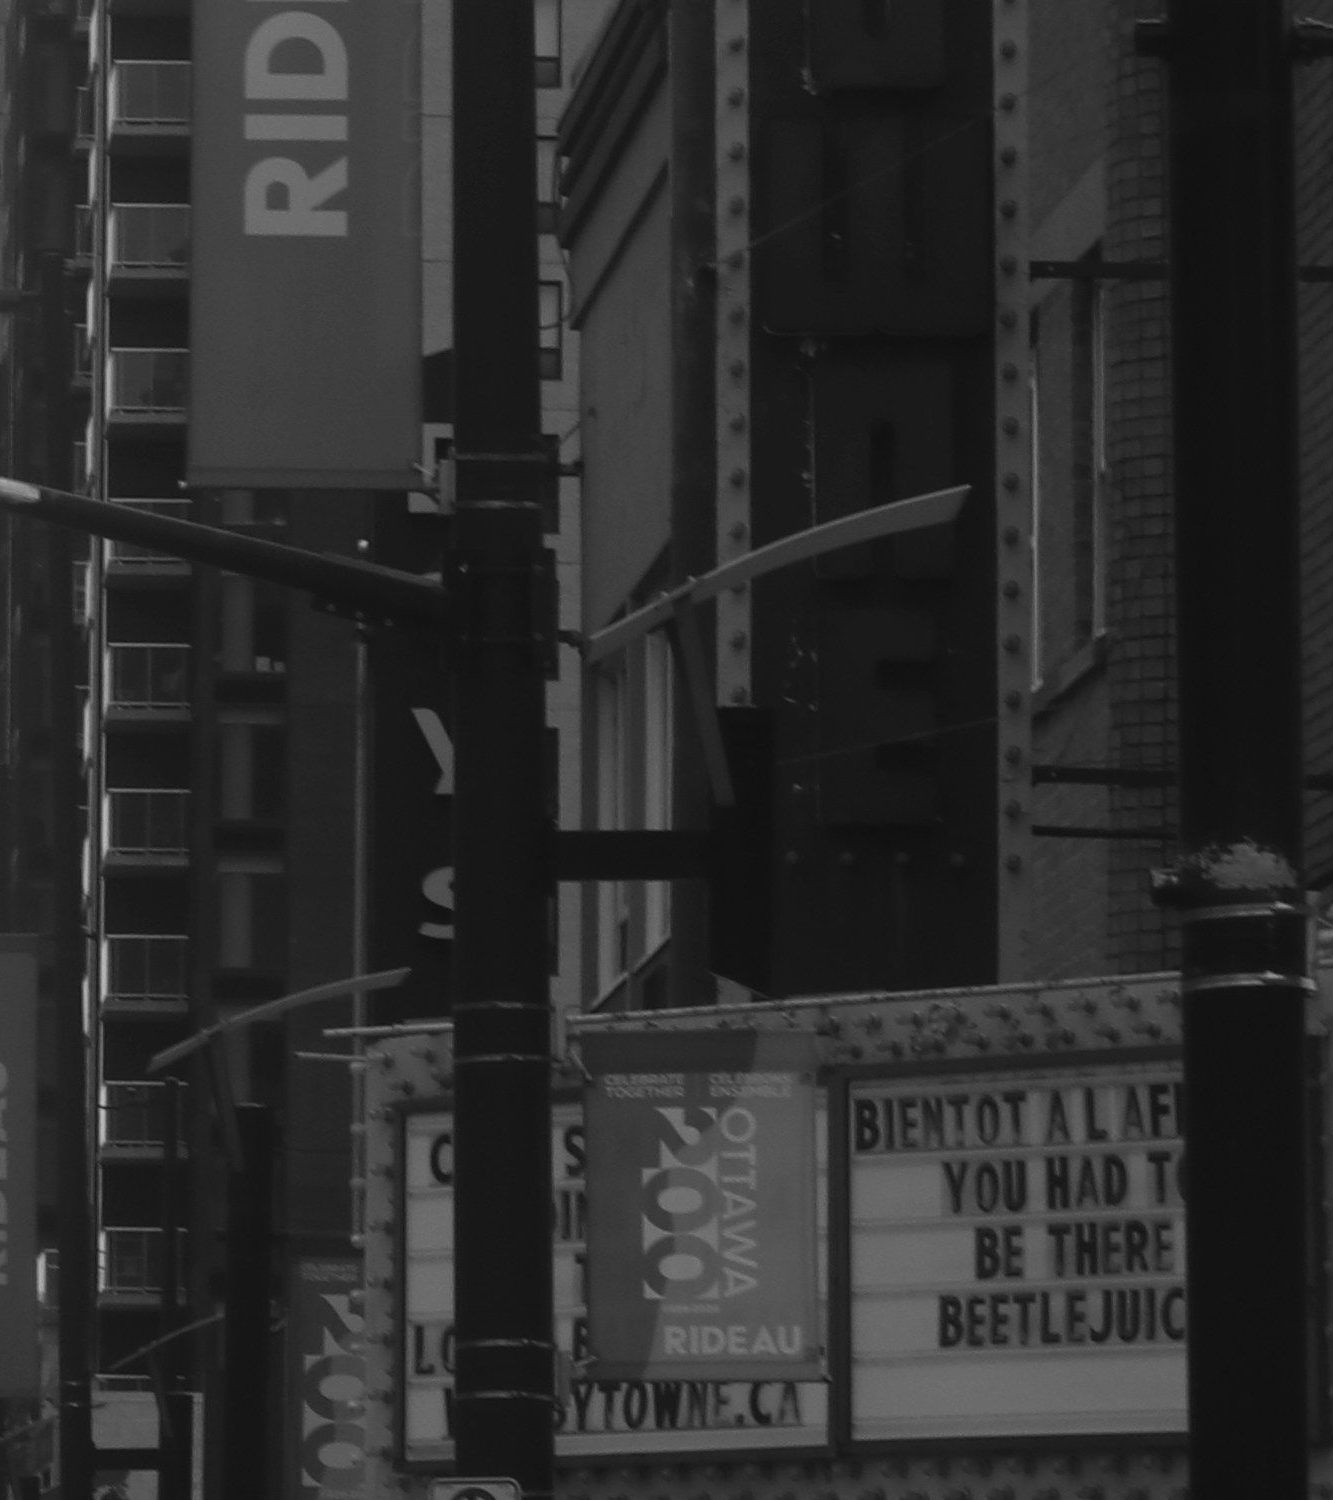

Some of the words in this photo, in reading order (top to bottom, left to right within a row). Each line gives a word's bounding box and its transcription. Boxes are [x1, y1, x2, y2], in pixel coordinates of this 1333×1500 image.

[854, 1090, 1027, 1151] BIENTOT
[1047, 1089, 1070, 1144] A
[1085, 1087, 1108, 1140] L
[719, 1106, 760, 1299] OTTAWA
[941, 1160, 1027, 1214] YOU
[1046, 1153, 1129, 1211] HAD
[973, 1225, 1025, 1281] BE
[1047, 1219, 1173, 1278] THERE
[663, 1324, 803, 1356] RIDEAU
[937, 1287, 1186, 1349] BEETLEJUIC
